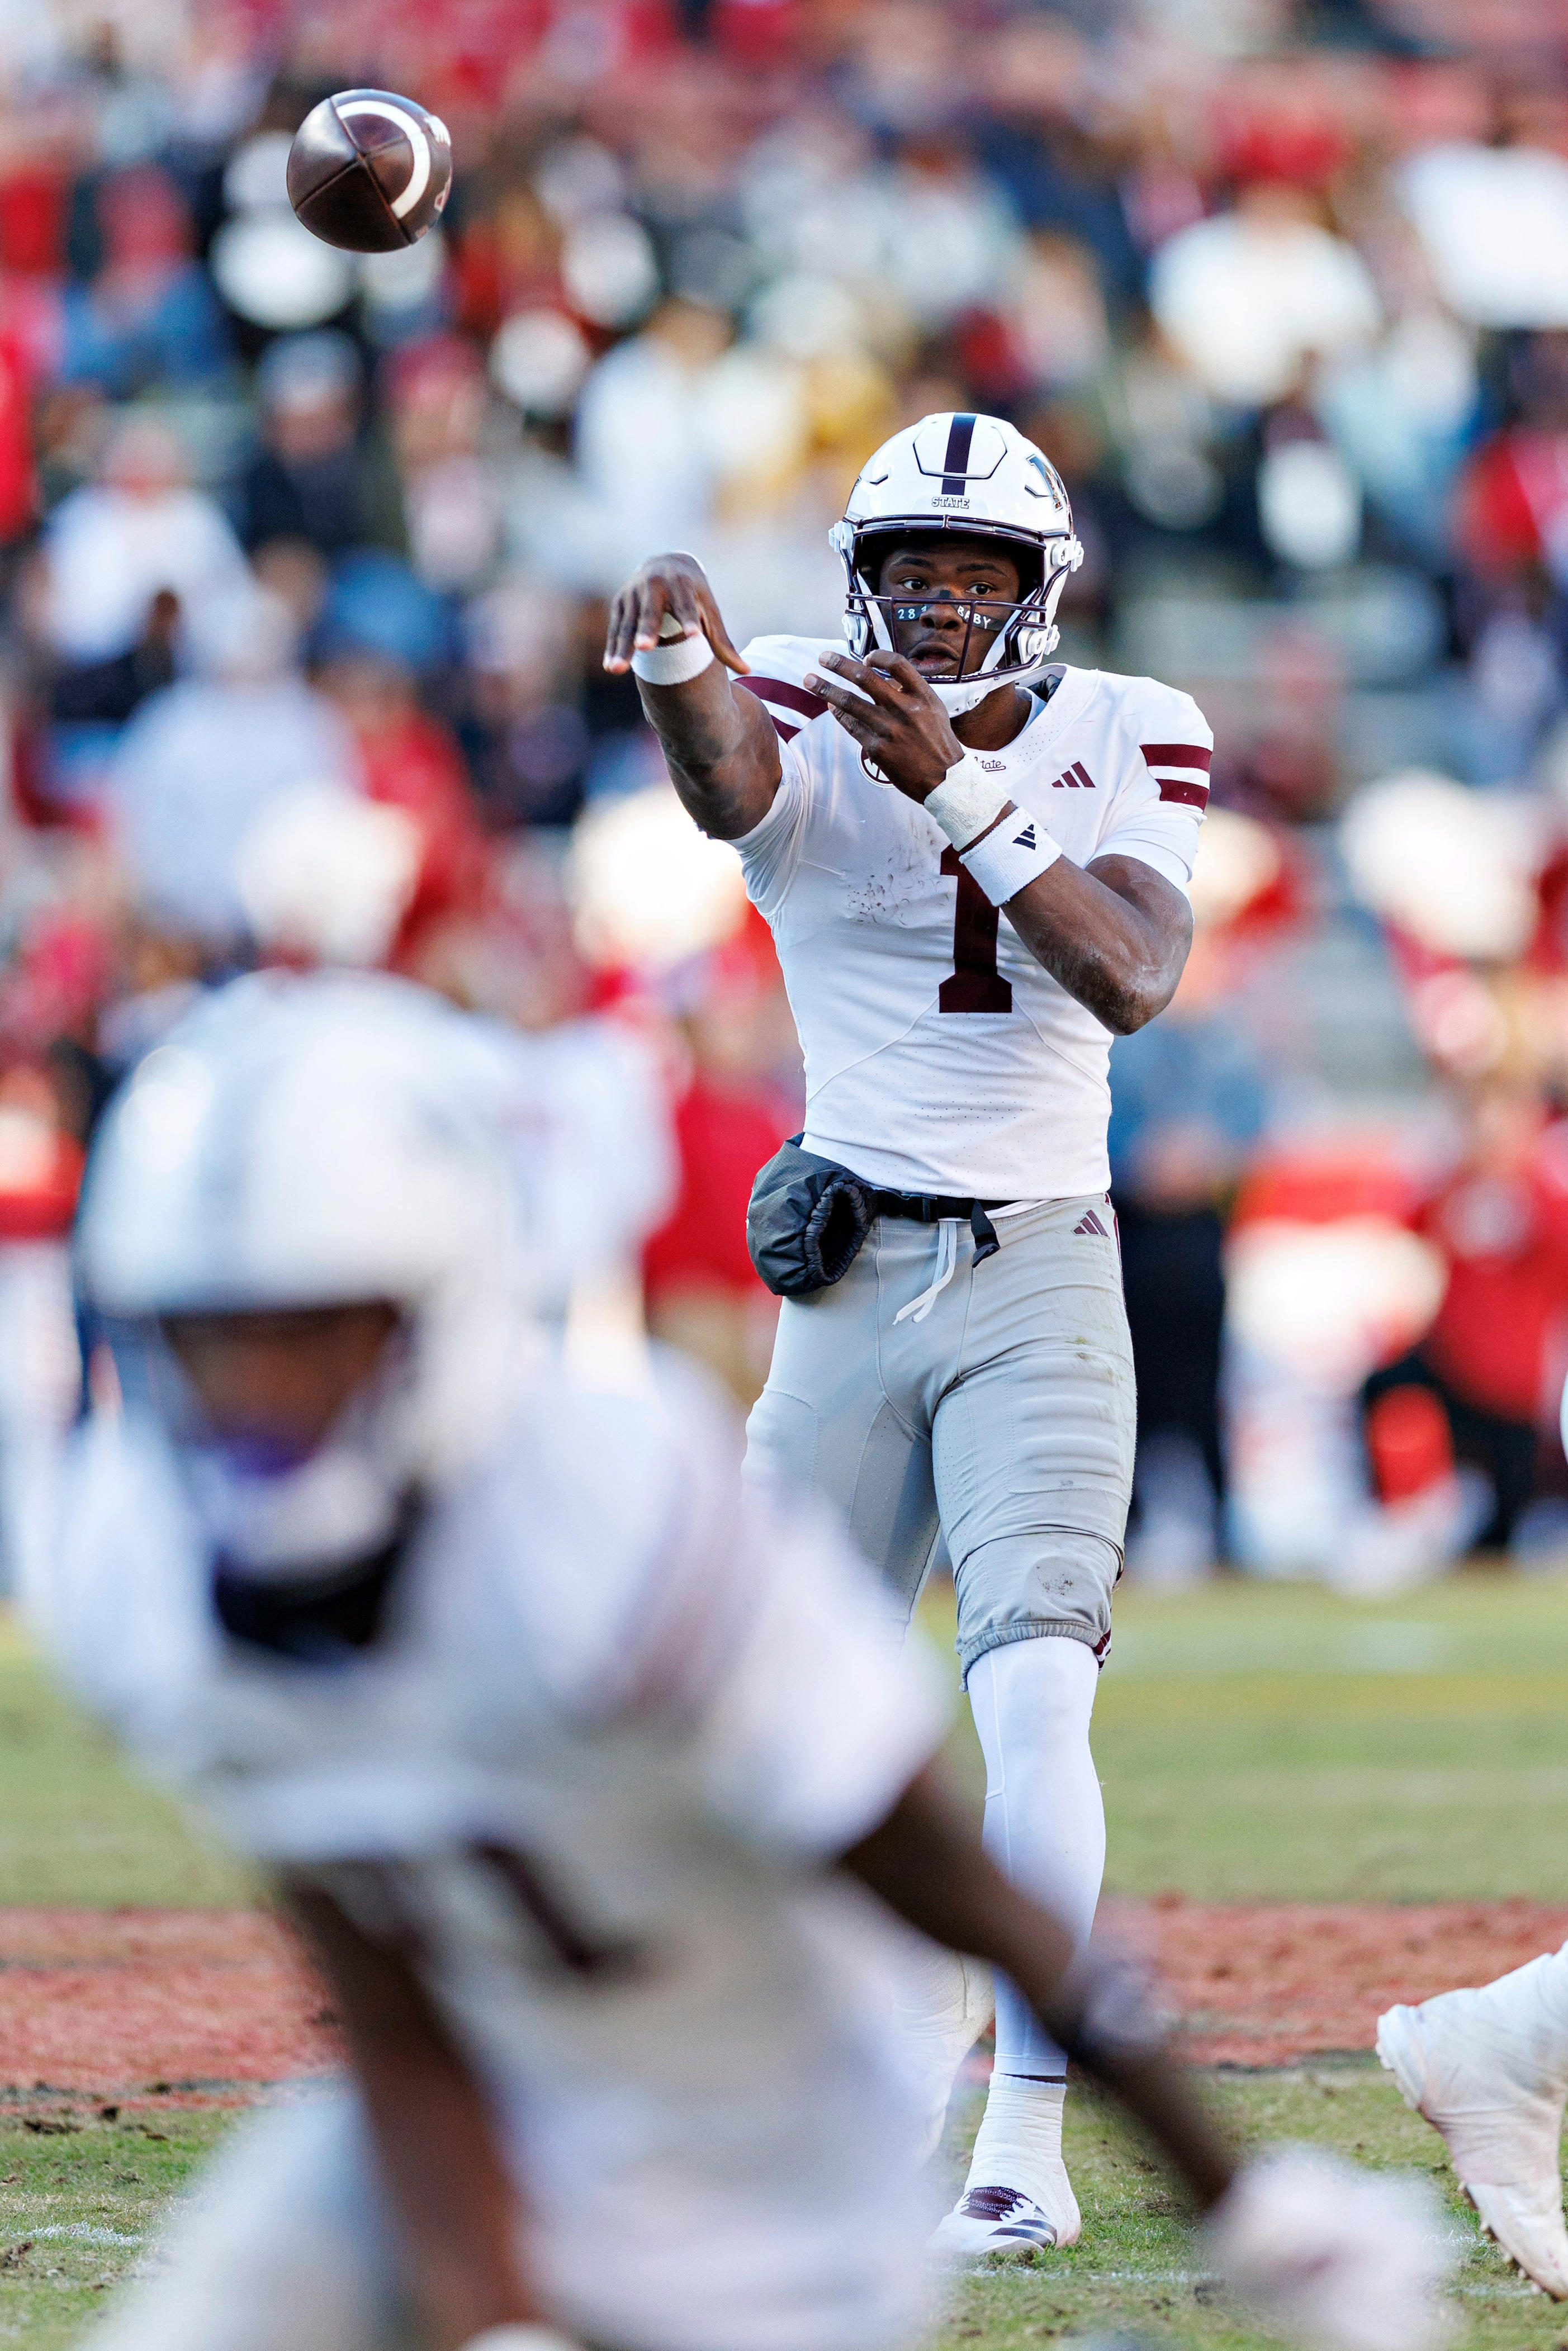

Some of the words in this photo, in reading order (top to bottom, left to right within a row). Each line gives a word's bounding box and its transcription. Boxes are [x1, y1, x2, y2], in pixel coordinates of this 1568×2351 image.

[931, 496, 970, 509] STATE
[974, 756, 1006, 772] tate
[939, 843, 1012, 1013] 1
